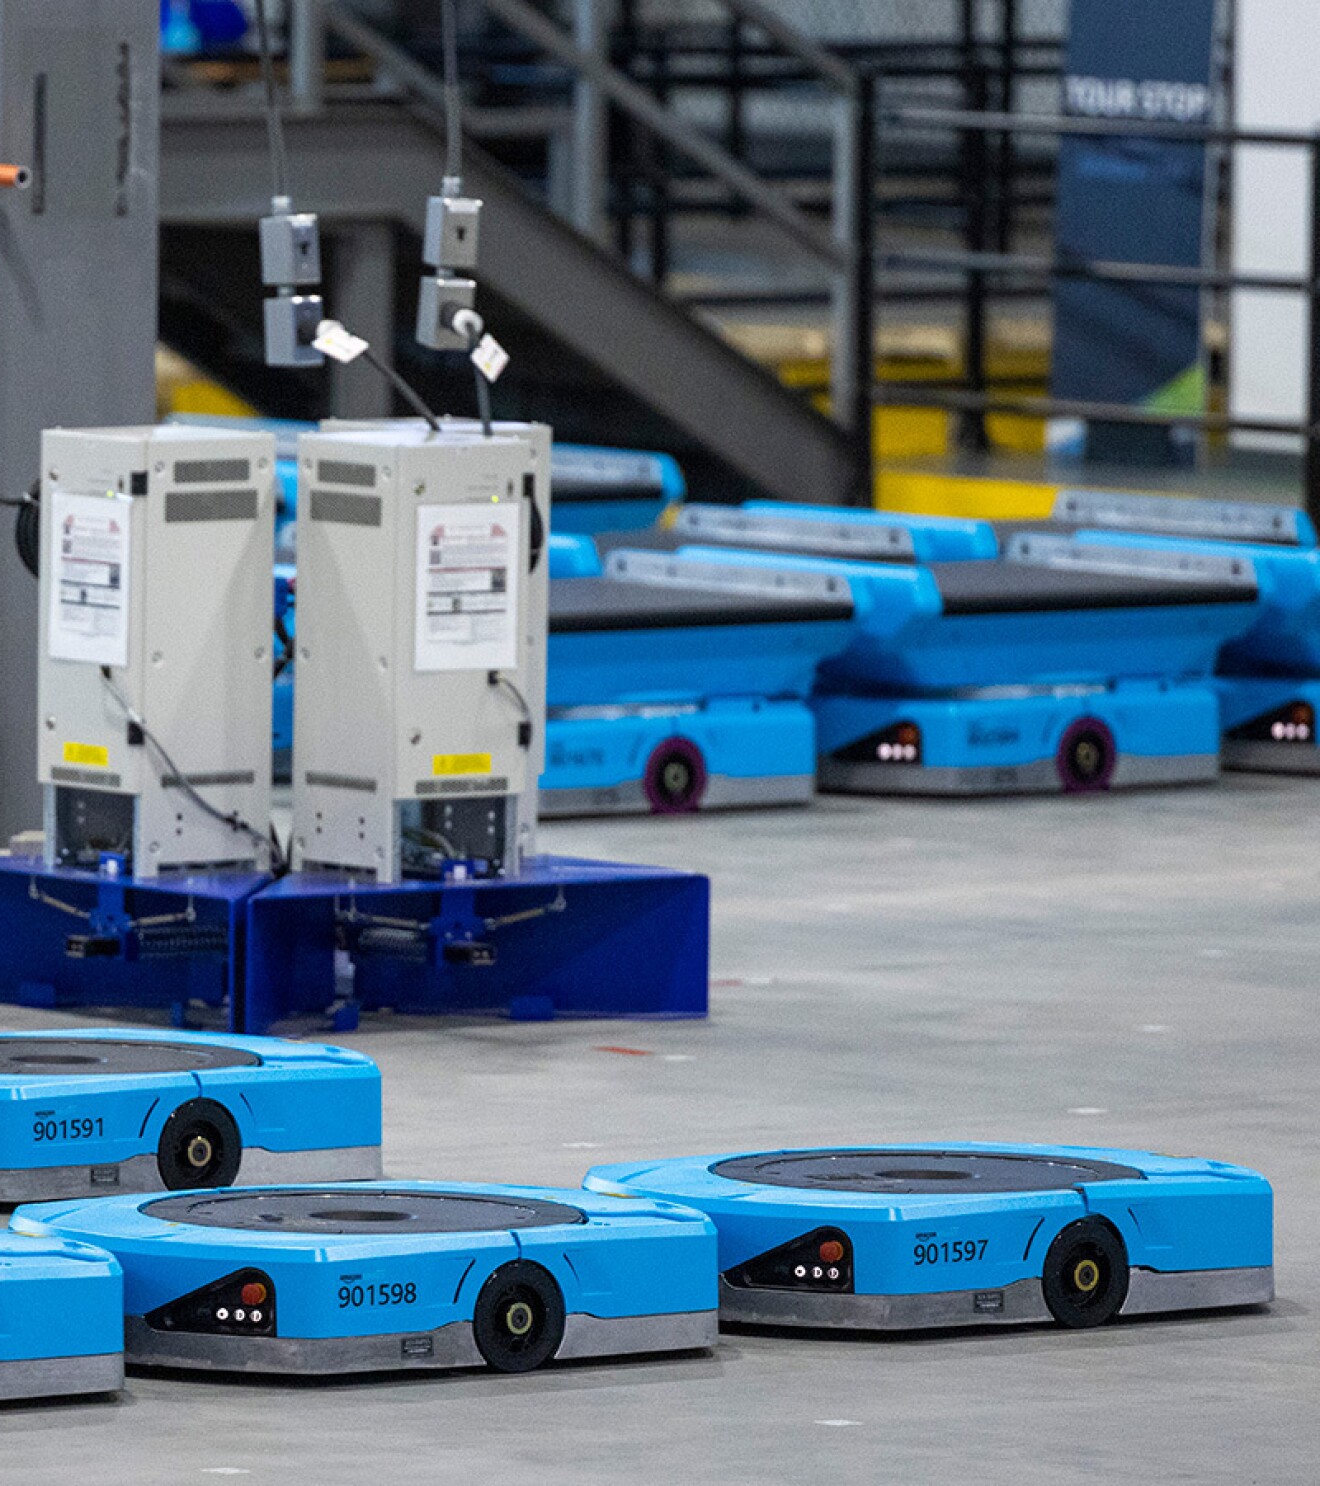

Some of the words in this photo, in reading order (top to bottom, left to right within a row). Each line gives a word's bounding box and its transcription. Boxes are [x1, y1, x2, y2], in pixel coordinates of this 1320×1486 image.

[33, 1117, 104, 1141] 901591
[913, 1239, 989, 1266] 901597
[338, 1282, 417, 1309] 901598
